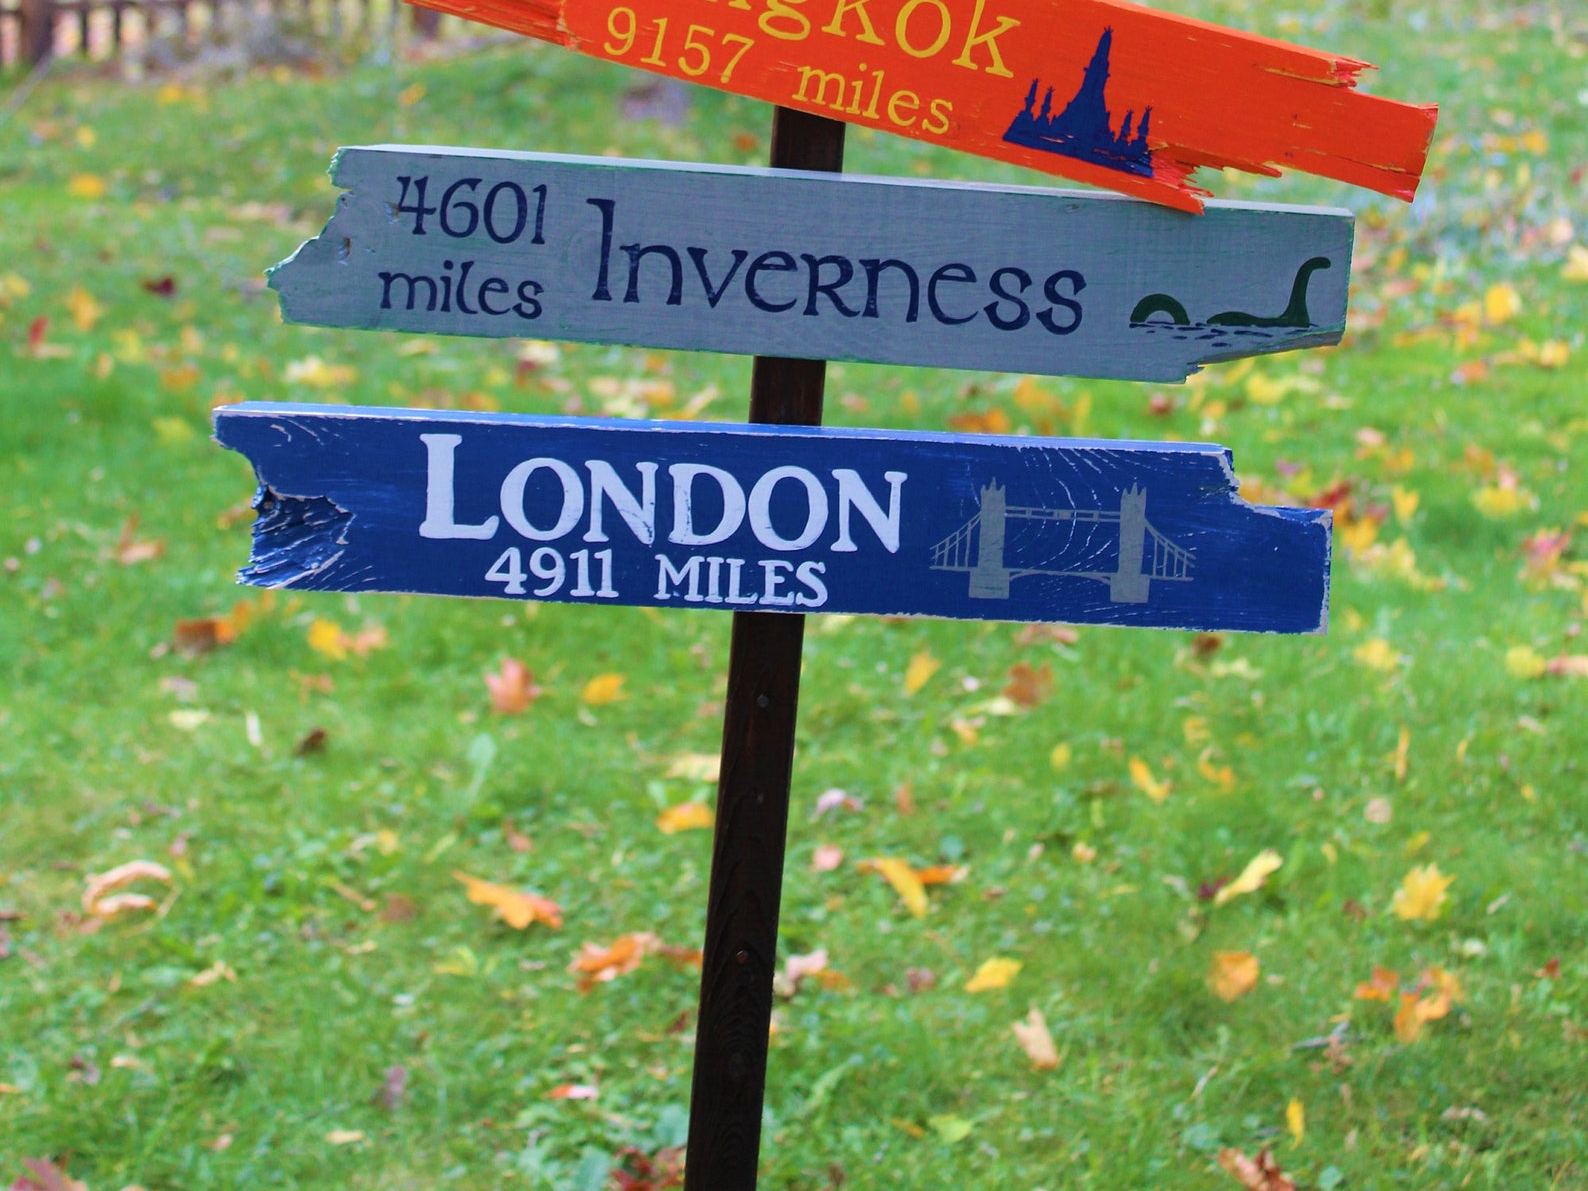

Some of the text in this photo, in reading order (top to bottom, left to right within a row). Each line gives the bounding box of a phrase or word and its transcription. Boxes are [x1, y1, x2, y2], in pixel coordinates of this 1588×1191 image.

[602, 6, 955, 135] 9157 miles
[395, 175, 549, 246] 4601
[378, 259, 544, 320] miles
[585, 197, 1088, 336] Inverness
[418, 433, 908, 554] LONDON
[484, 546, 829, 608] 4911 MILES
